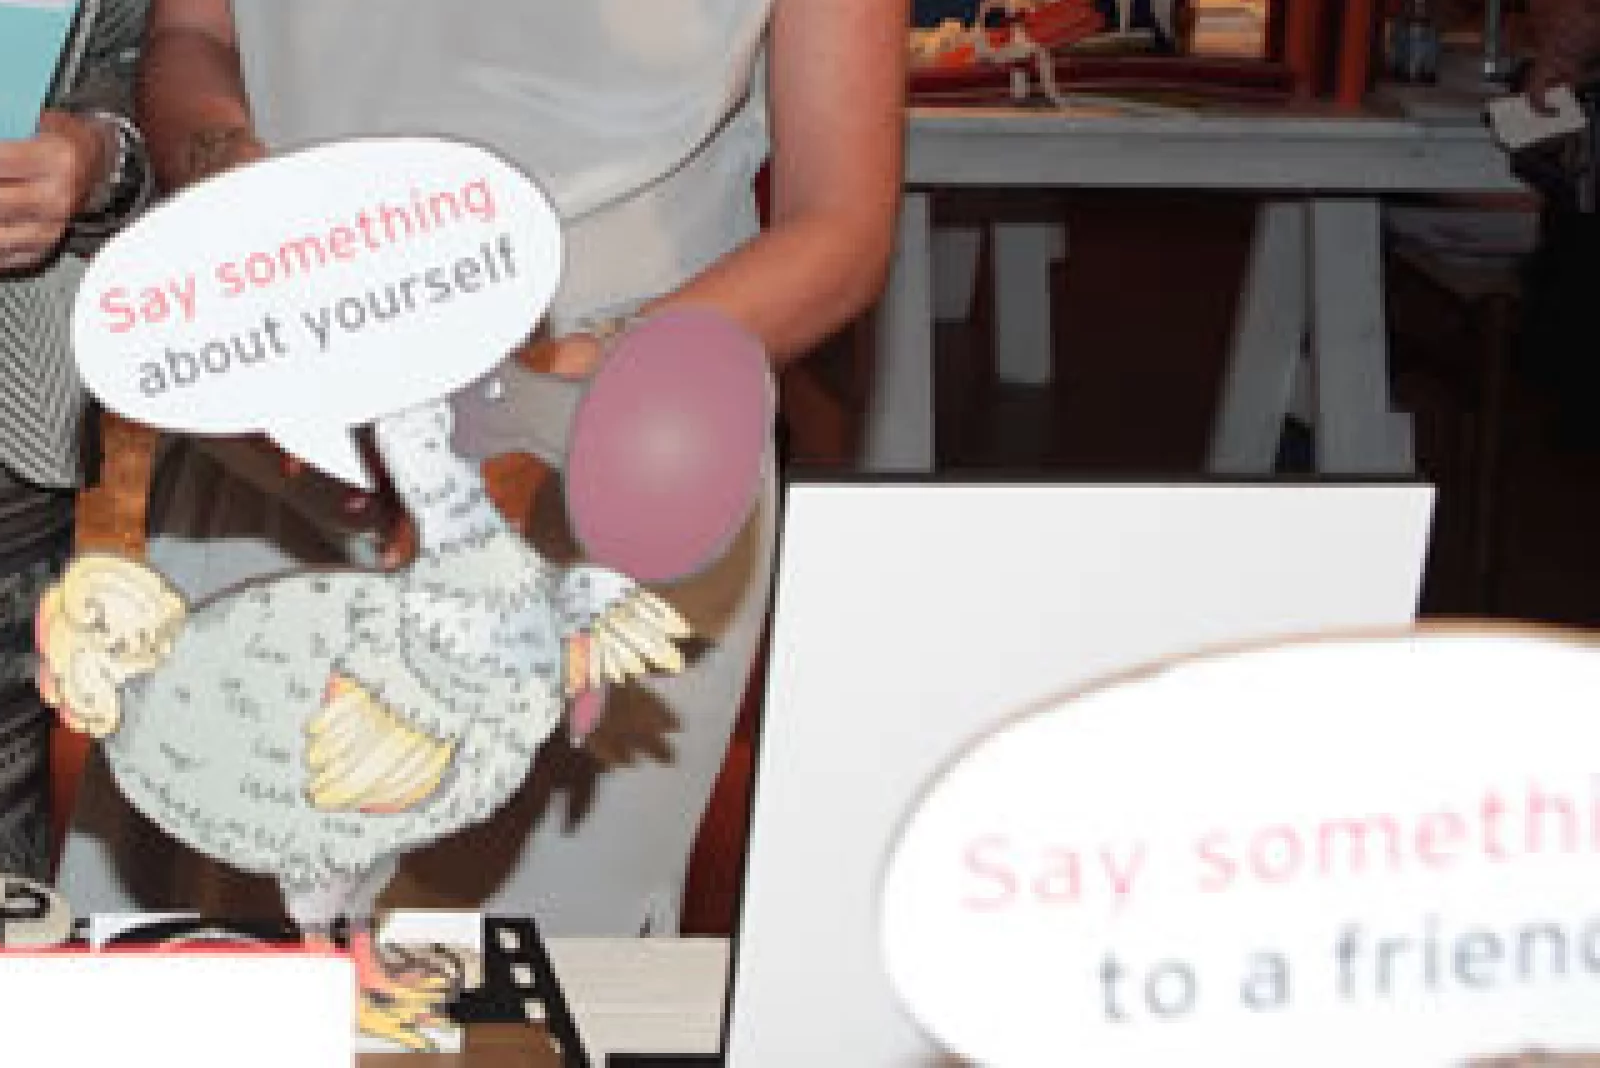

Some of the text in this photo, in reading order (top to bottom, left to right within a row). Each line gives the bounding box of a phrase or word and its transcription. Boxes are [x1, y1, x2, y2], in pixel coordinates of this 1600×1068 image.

[99, 174, 498, 334] Say something
[137, 233, 518, 398] about yourself
[959, 833, 1148, 922] Say
[1098, 949, 1199, 1024] to
[1238, 950, 1294, 1014] a
